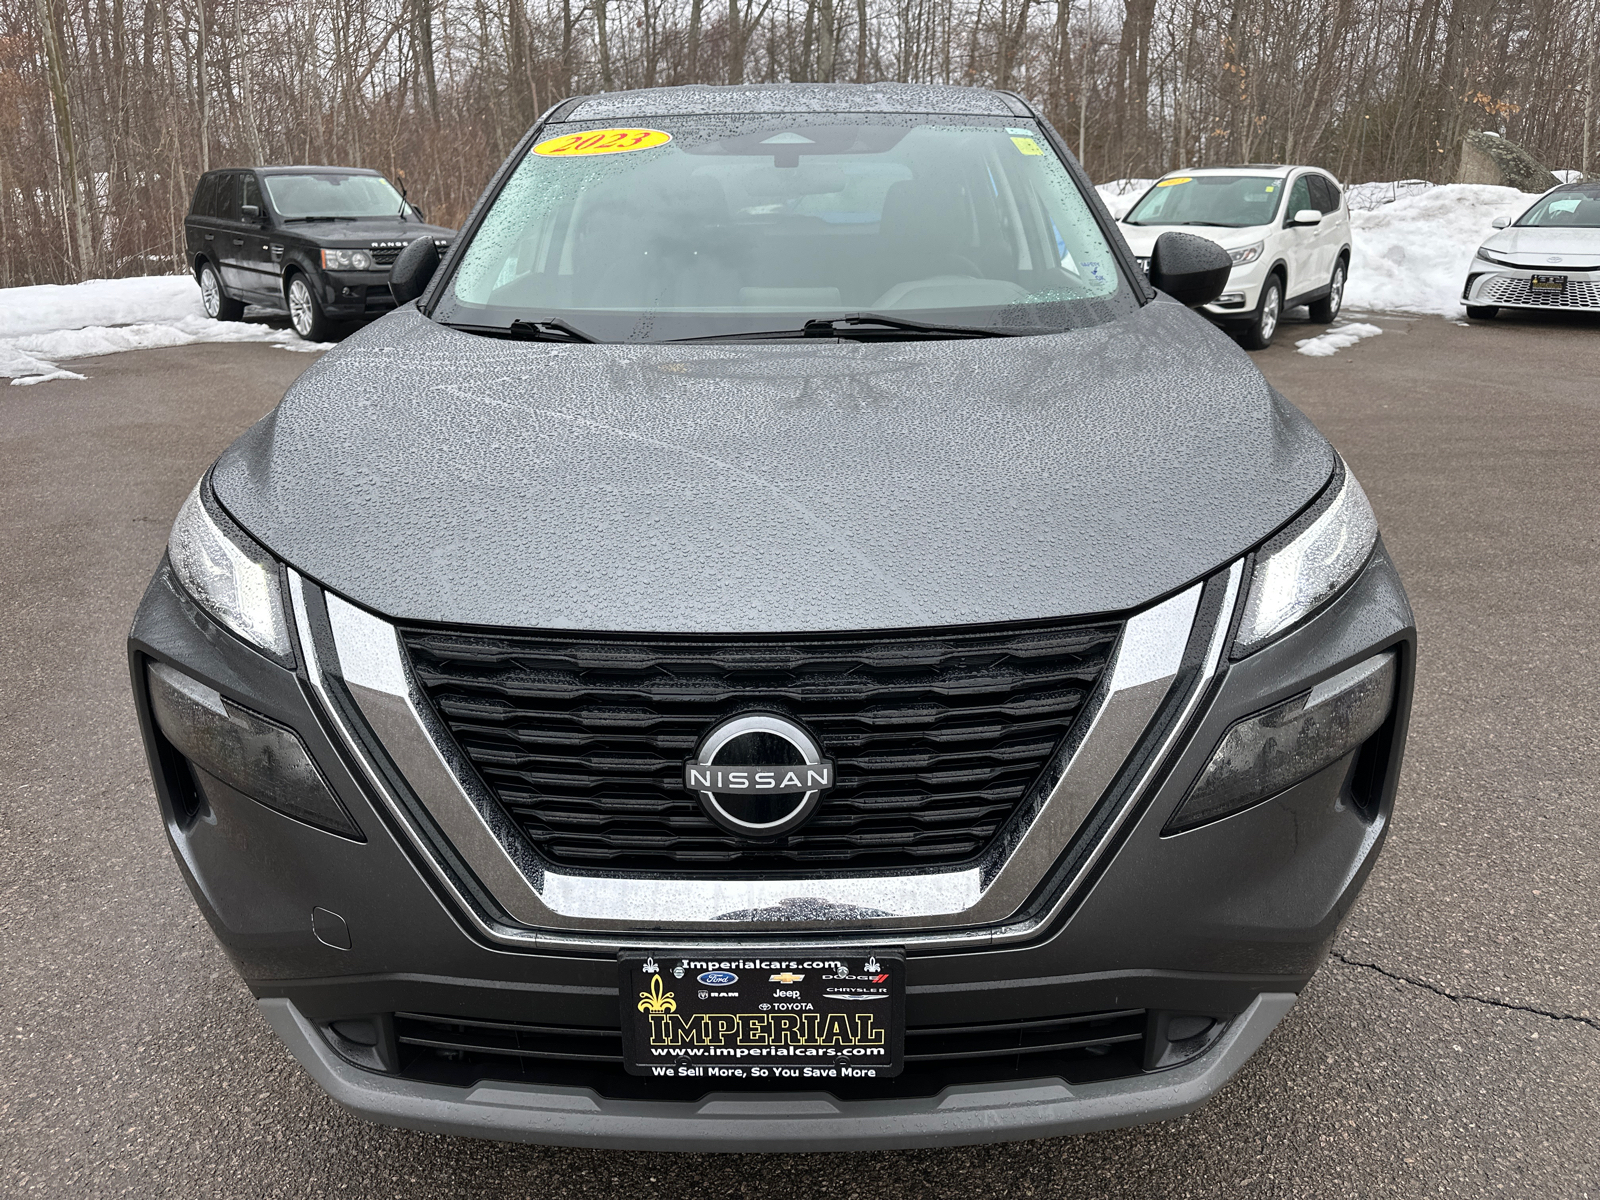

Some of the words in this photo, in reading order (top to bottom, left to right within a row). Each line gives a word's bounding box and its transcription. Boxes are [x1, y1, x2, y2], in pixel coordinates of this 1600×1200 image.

[549, 132, 651, 153] 2023
[690, 768, 828, 789] NISSAN
[681, 959, 842, 971] Imperialcars.com
[773, 989, 800, 999] Jeep
[773, 1003, 814, 1011] TOYOTA
[649, 1014, 885, 1046] IMPERIAL
[651, 1046, 885, 1058] www.imperialcars.com
[652, 1067, 675, 1077] We
[678, 1067, 704, 1077] Sell
[708, 1067, 747, 1078] More,
[751, 1067, 769, 1077] So
[773, 1067, 799, 1077] You
[803, 1067, 837, 1077] Save
[841, 1067, 876, 1077] More
